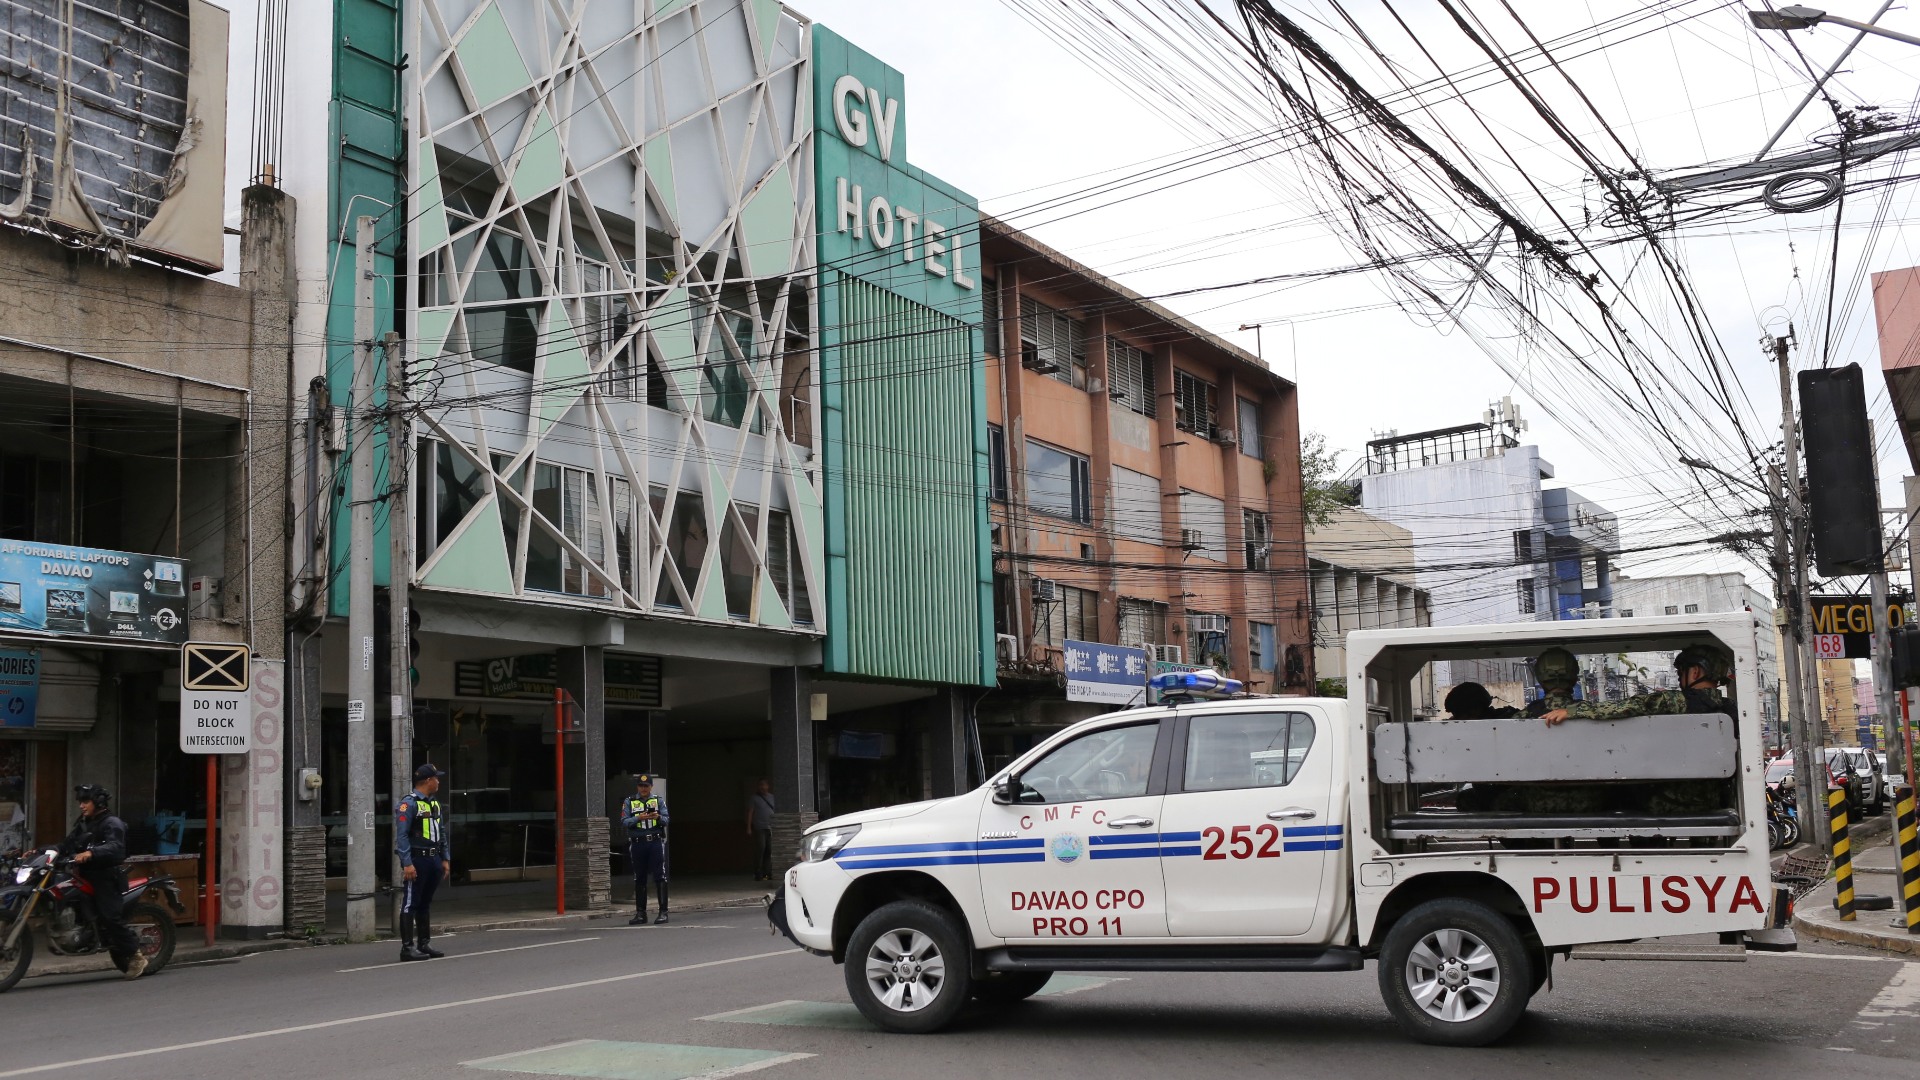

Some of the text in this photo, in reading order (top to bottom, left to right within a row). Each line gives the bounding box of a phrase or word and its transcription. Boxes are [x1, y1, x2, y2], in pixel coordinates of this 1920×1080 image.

[833, 74, 898, 163] GV
[836, 176, 975, 290] HOTEL
[2, 544, 129, 566] AFFORDABLE LAPTOPS
[41, 561, 93, 578] DAVAO
[150, 614, 182, 625] RYZEN
[488, 657, 515, 682] GV
[492, 679, 518, 693] Hotels
[193, 700, 239, 710] DO NOT
[197, 718, 234, 728] BLOCK
[186, 735, 245, 746] INTERSECTION
[981, 831, 1018, 839] HILUX
[1202, 823, 1281, 861] 252
[1011, 889, 1145, 911] DAVAO CPO
[1532, 875, 1765, 914] PULISYA
[1032, 916, 1123, 936] PRO 11
